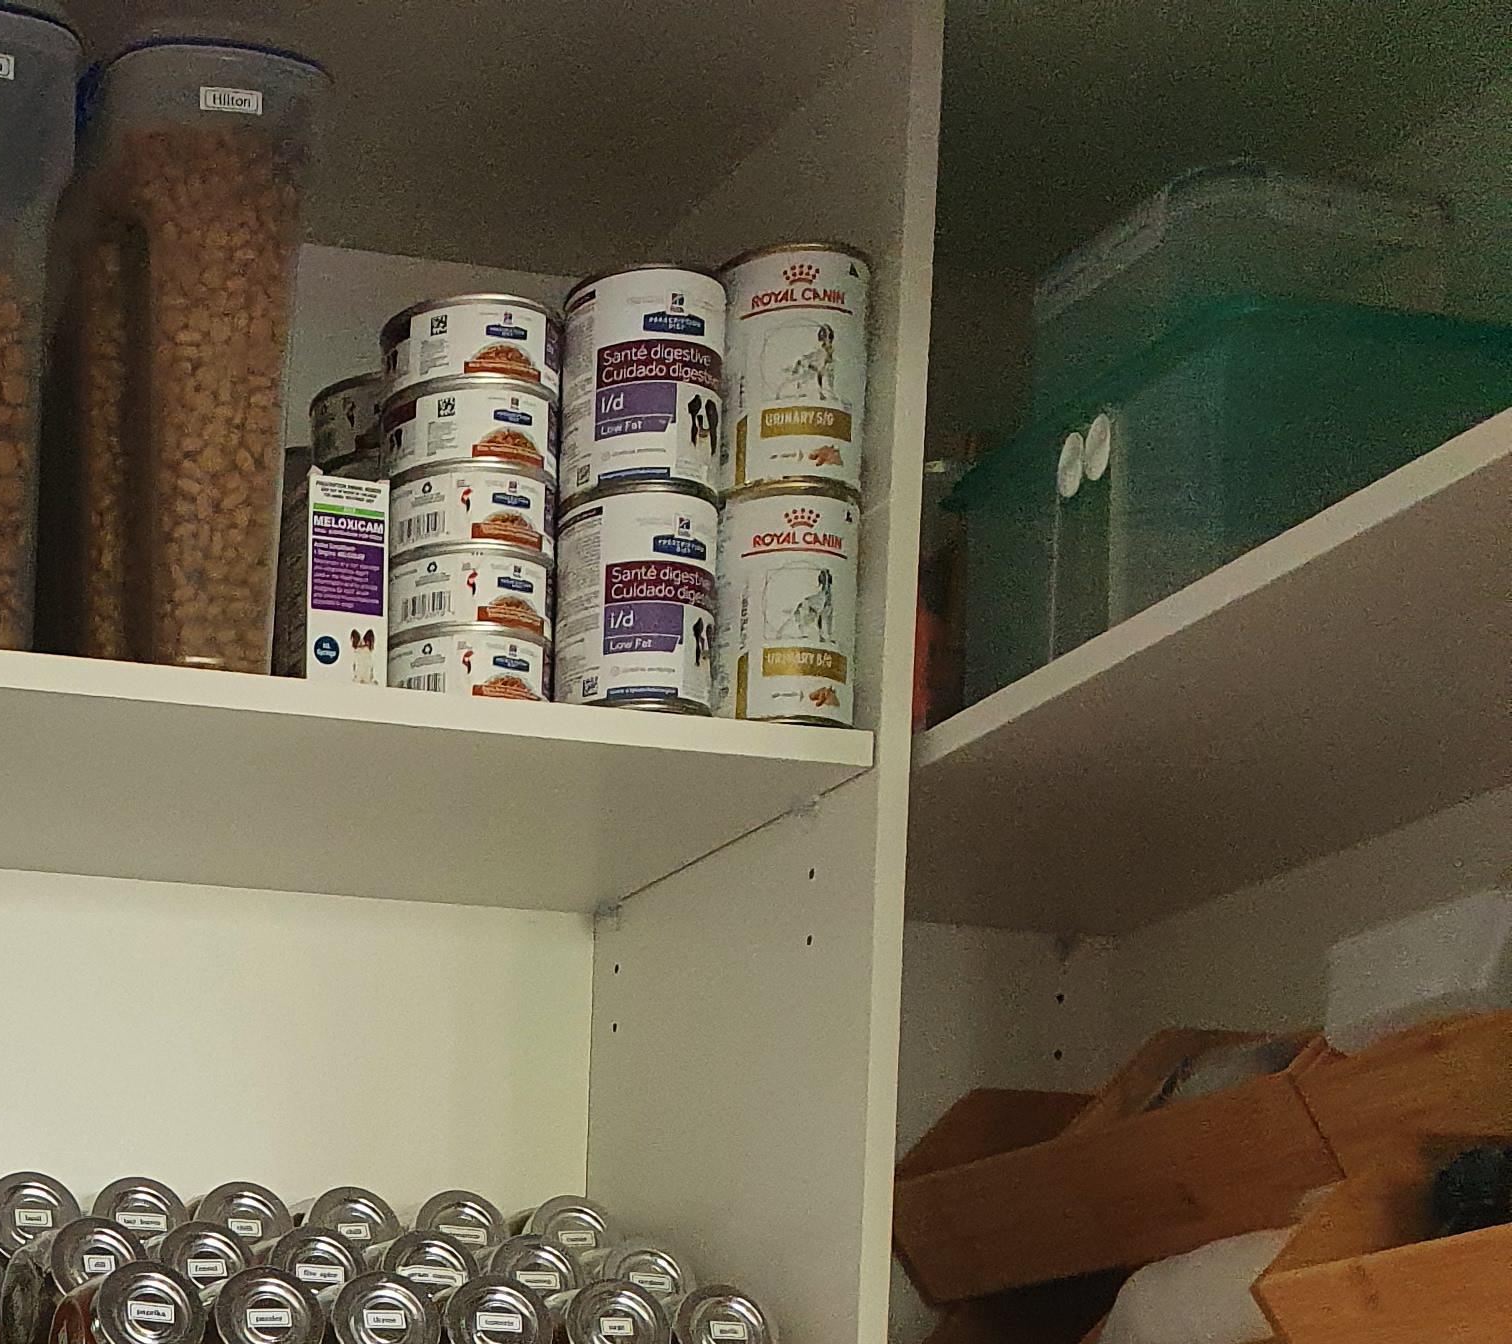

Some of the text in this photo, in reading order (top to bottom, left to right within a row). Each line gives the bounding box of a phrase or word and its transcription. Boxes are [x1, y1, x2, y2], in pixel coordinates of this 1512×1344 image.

[752, 288, 846, 310] ROYAL CANIN
[313, 514, 385, 536] MELOXICAM
[752, 532, 843, 550] ROYAL CANIN
[611, 583, 675, 599] Cuidado
